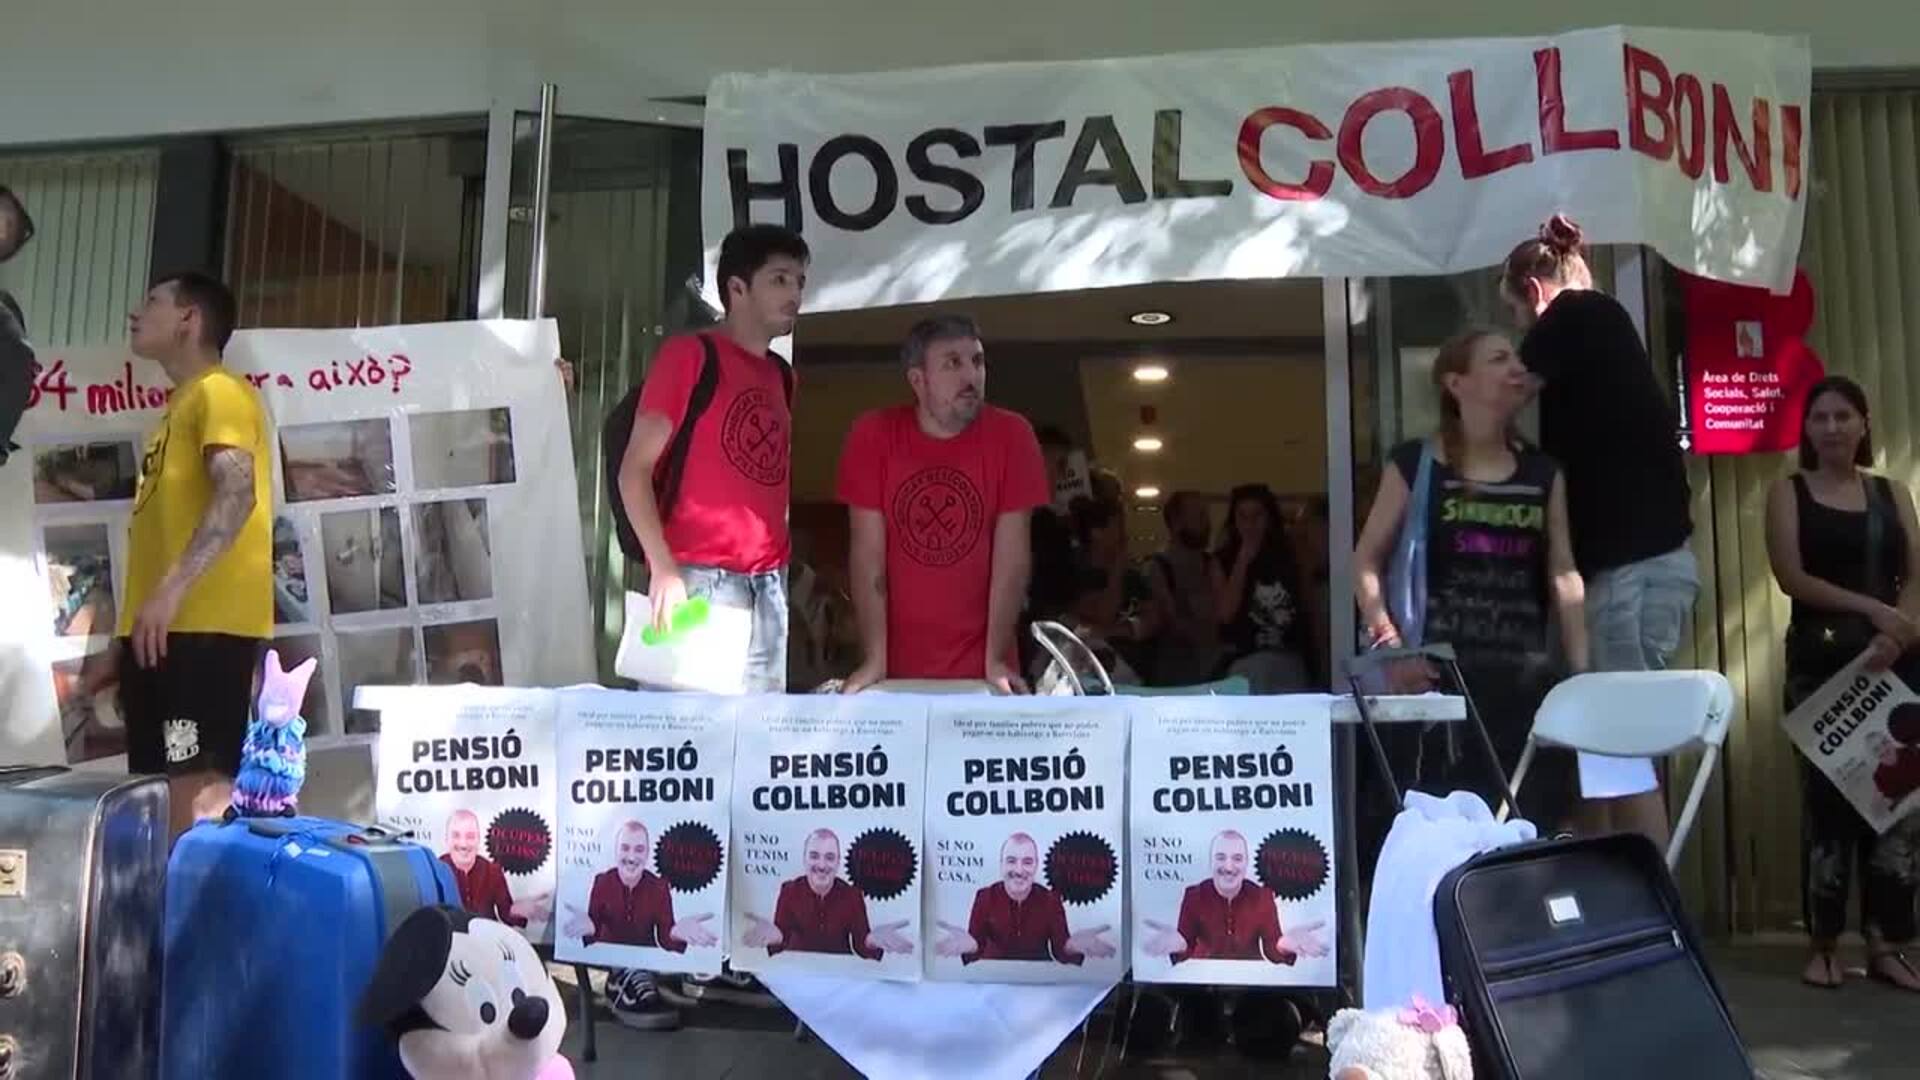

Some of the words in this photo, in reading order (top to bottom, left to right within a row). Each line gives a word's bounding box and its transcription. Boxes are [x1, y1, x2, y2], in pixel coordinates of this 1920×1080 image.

[1731, 372, 1746, 383] de
[1749, 372, 1779, 383] Drets
[1704, 402, 1767, 416] Cooperació
[1705, 418, 1764, 429] Comunitat
[1819, 679, 1893, 756] COLLBONI
[412, 728, 522, 763] PENSIÓ
[585, 739, 698, 773] PENSIÓ
[770, 744, 888, 779] PENSIÓ
[964, 746, 1086, 784] PENSIÓ
[1169, 744, 1293, 780] PENSIÓ
[397, 764, 539, 794] COLLBONI
[571, 777, 714, 804] COLLBONI
[752, 782, 906, 811] COLLBONI
[946, 785, 1105, 816] COLLBONI
[1153, 782, 1313, 813] COLLBONI
[744, 833, 756, 845] SI
[760, 834, 779, 846] NO
[937, 839, 950, 851] SI
[954, 840, 974, 851] NO
[1143, 837, 1156, 848] SI
[1161, 837, 1182, 848] NO
[746, 849, 788, 861] TENIM
[938, 855, 984, 867] TENIM
[1144, 853, 1192, 865] TENIM
